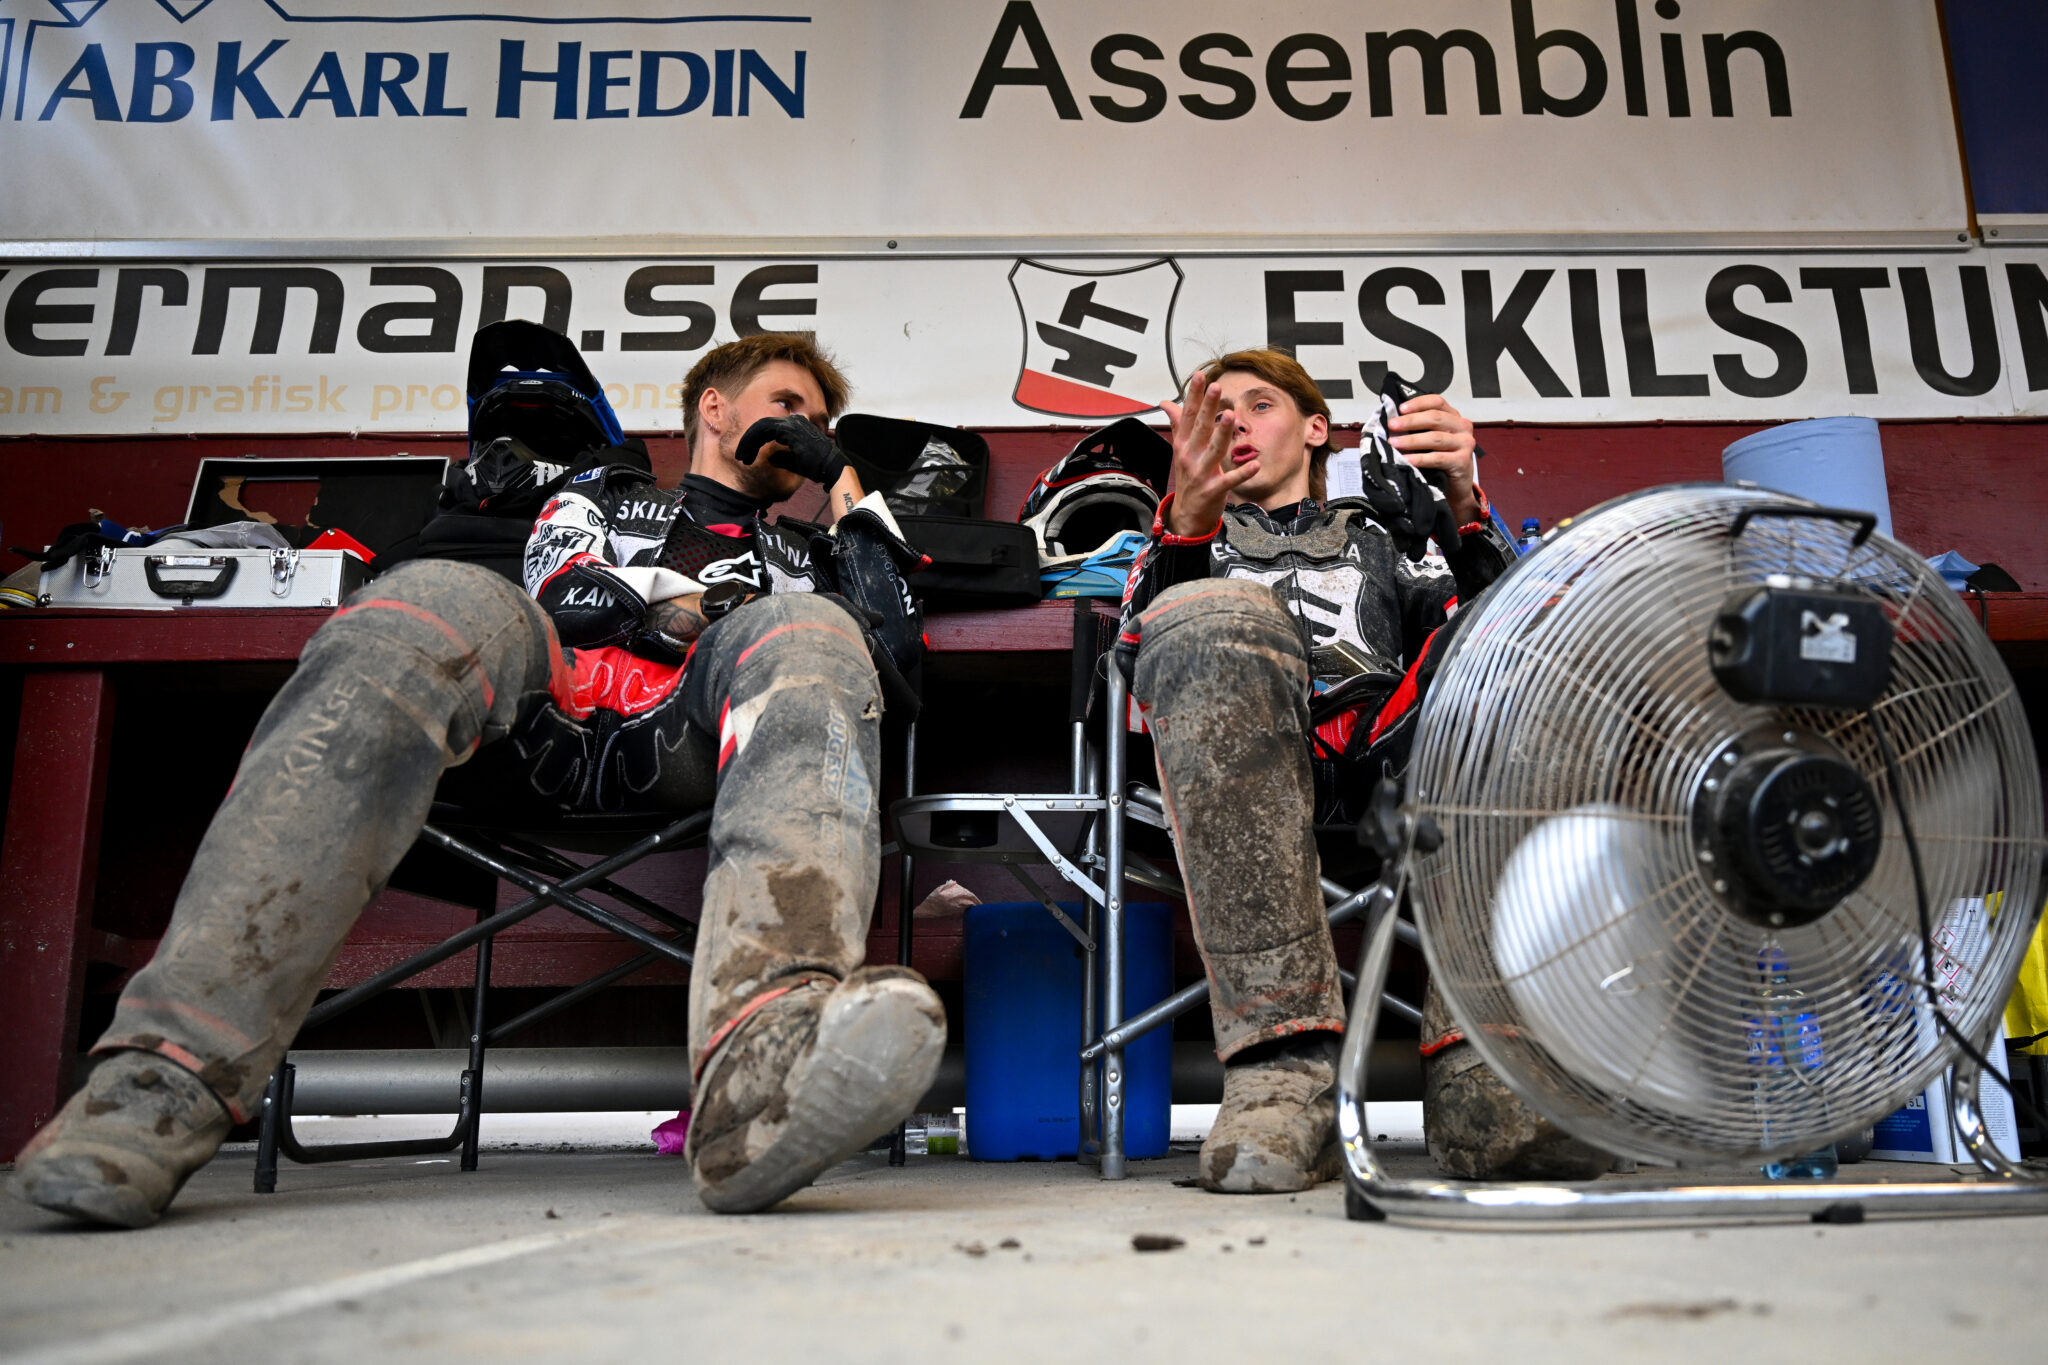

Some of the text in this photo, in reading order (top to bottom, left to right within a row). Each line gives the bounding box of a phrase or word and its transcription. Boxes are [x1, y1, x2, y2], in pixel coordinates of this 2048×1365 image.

[38, 39, 807, 123] AB KARL HEDIN
[959, 0, 1793, 124] Assemblin
[0, 265, 818, 357] erman.se
[89, 376, 130, 414] &
[153, 375, 348, 422] grafisk
